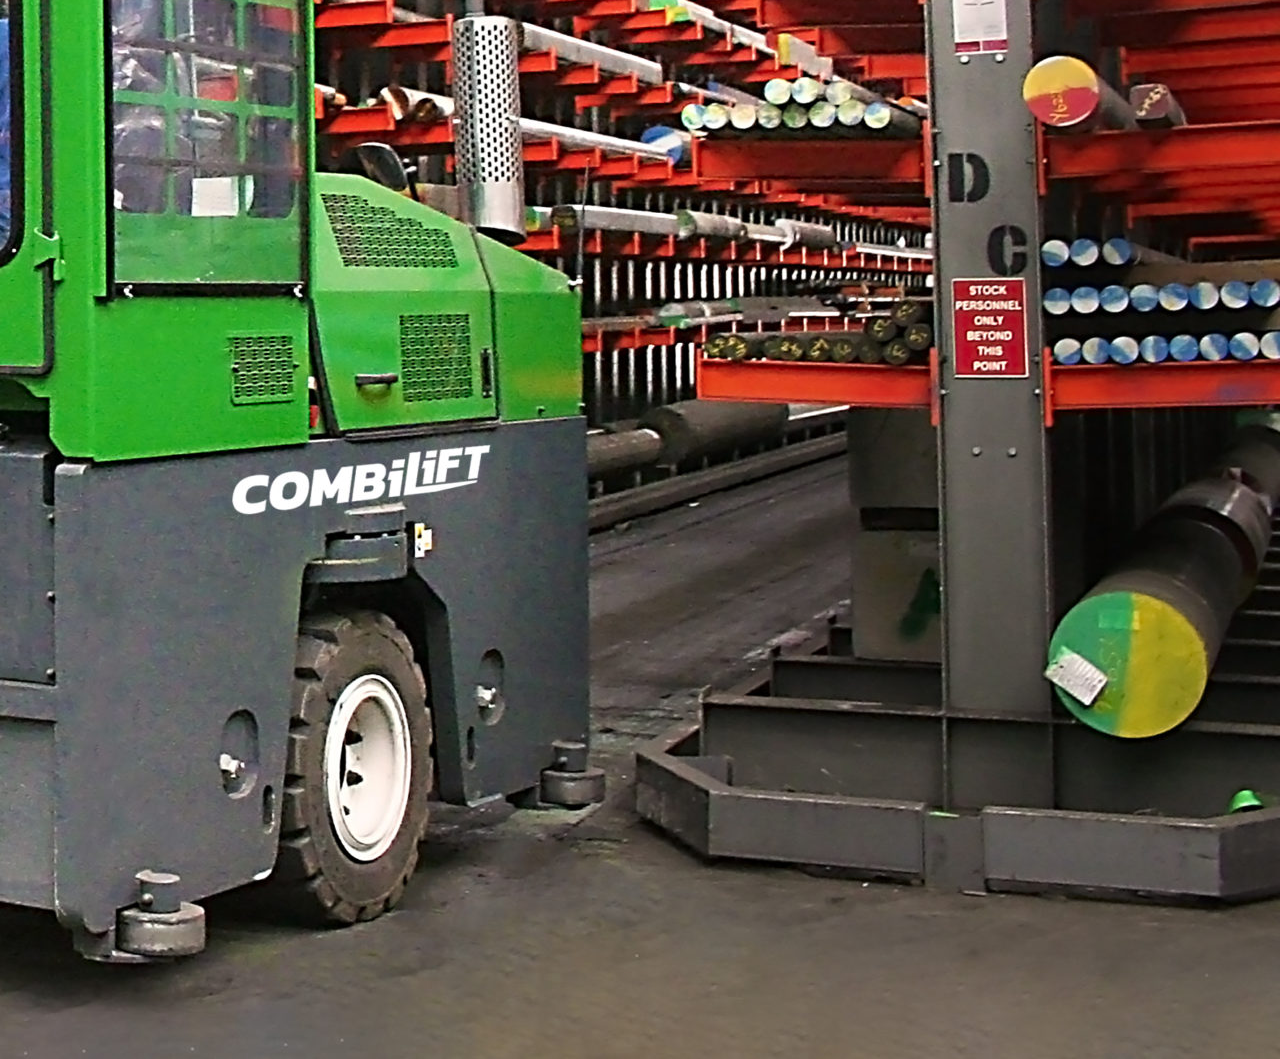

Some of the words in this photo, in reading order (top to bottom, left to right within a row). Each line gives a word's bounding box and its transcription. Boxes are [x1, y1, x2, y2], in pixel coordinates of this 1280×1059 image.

[948, 152, 991, 203] D
[987, 224, 1029, 277] C
[968, 285, 1007, 295] STOCK
[955, 300, 1022, 310] PERSONNEL
[974, 316, 1004, 326] ONLY
[966, 331, 1013, 341] BEYOND
[977, 346, 1003, 356] THIS
[973, 361, 1008, 371] POINT
